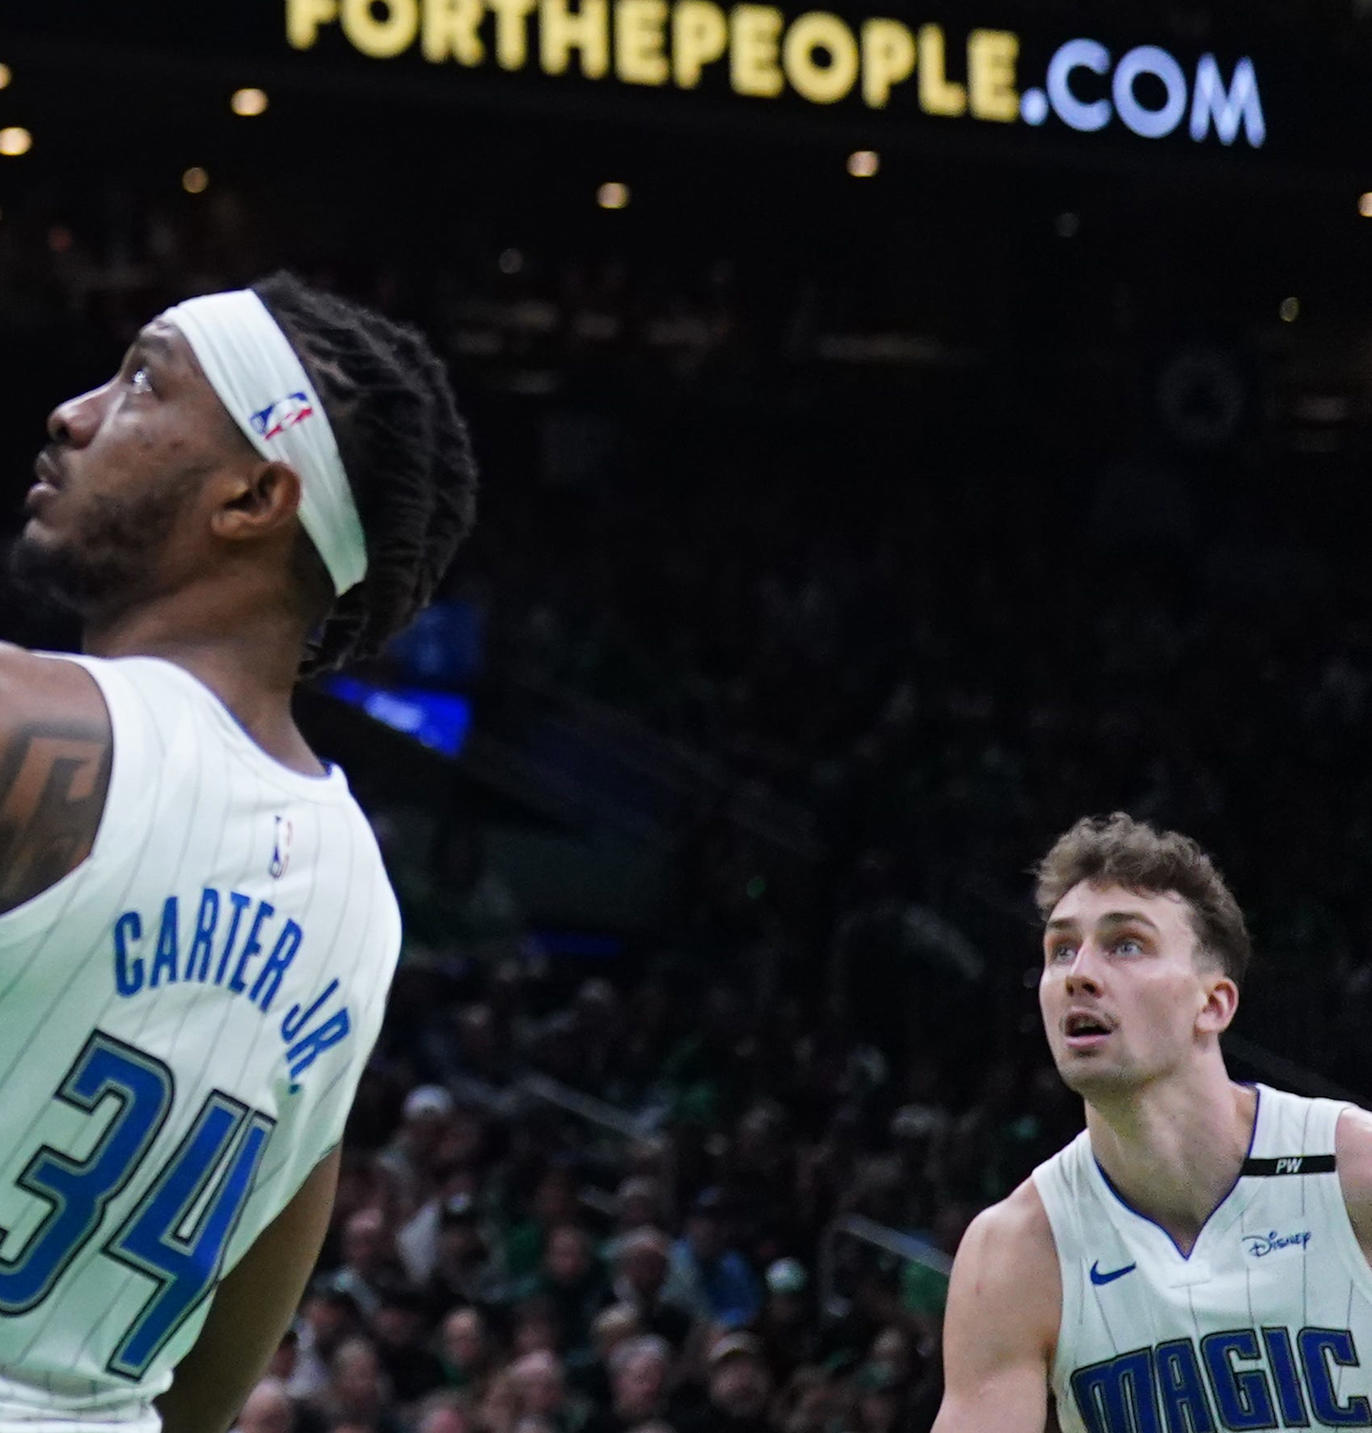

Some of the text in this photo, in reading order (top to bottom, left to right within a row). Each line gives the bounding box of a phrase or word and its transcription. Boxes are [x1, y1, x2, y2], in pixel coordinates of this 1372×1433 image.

[113, 887, 304, 1013] CARTER
[1276, 1157, 1303, 1174] PW
[1070, 1325, 1372, 1433] MAGIC
